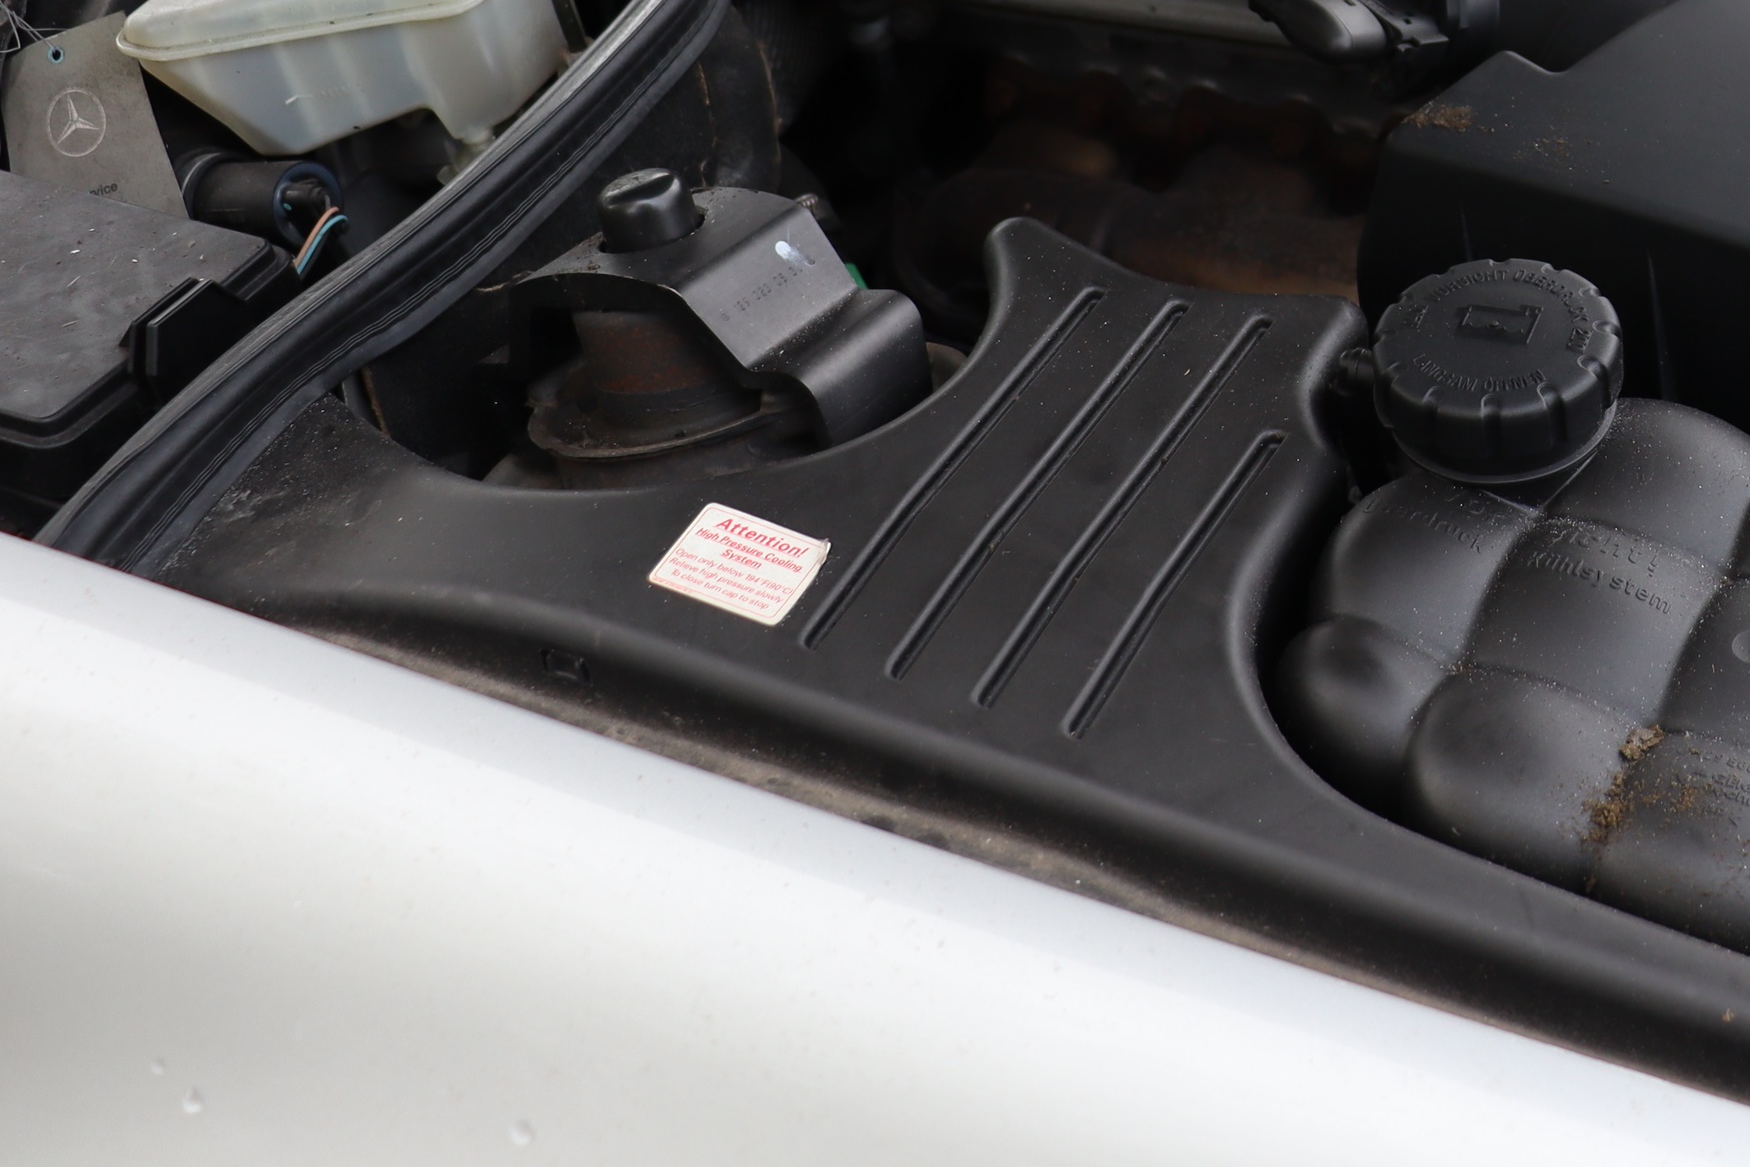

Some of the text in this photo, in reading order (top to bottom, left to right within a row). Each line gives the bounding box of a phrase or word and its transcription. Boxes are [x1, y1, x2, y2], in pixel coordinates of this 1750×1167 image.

[696, 527, 803, 573] High Pressure Cooling
[715, 518, 809, 557] Attention!
[675, 548, 699, 562] Open
[700, 556, 716, 569] only
[717, 562, 744, 578] below
[722, 549, 762, 569] System
[669, 557, 784, 604] Relieve high pressure slowly
[670, 569, 681, 578] To
[681, 573, 704, 585] close
[705, 582, 722, 593] turn
[721, 587, 738, 599] cap
[739, 593, 749, 603] to
[748, 597, 770, 610] stop
